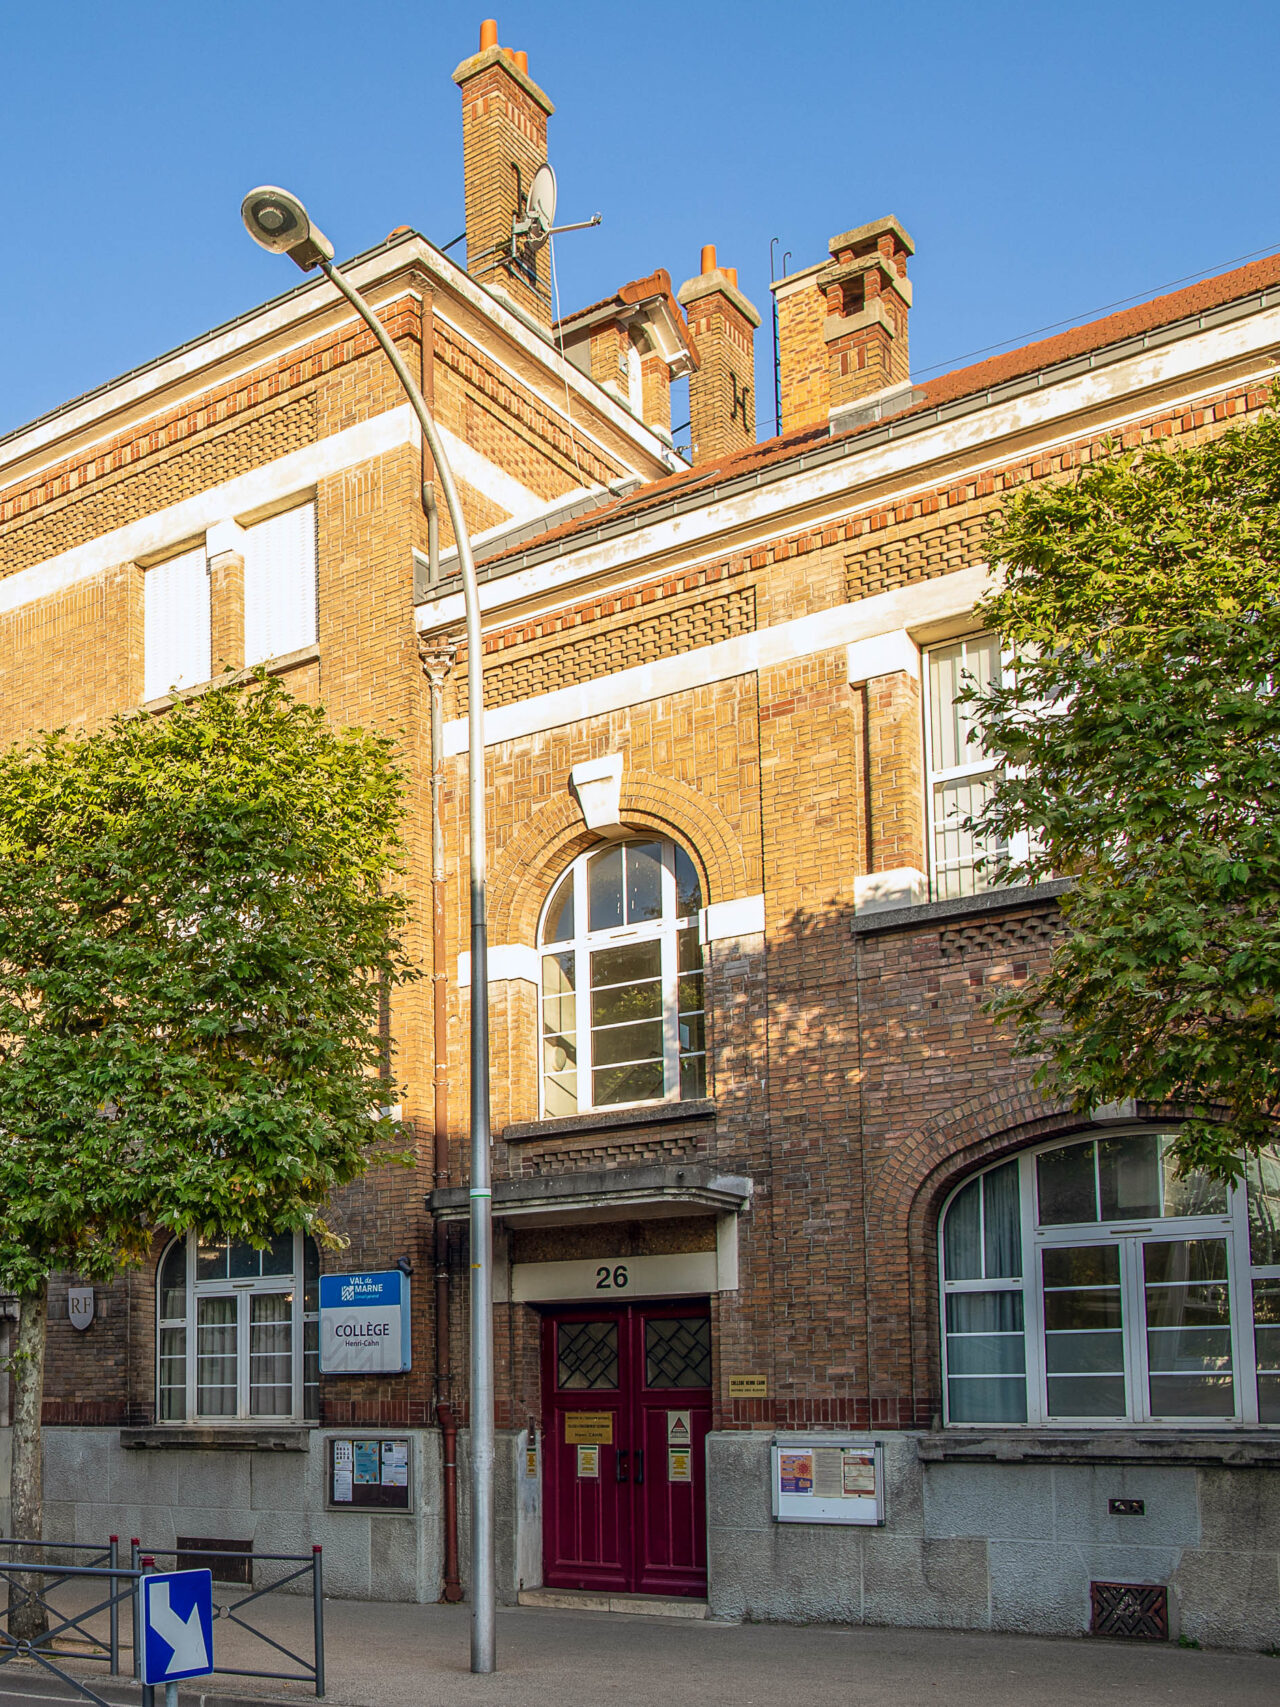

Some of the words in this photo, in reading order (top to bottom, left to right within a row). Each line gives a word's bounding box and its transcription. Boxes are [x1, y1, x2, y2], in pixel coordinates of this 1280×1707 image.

[349, 1277, 364, 1285] VAL
[596, 1264, 629, 1289] 26
[354, 1283, 383, 1293] MARNE
[71, 1296, 92, 1314] RF
[335, 1321, 390, 1338] COLLÈGE
[345, 1339, 380, 1348] Henri-Cahn
